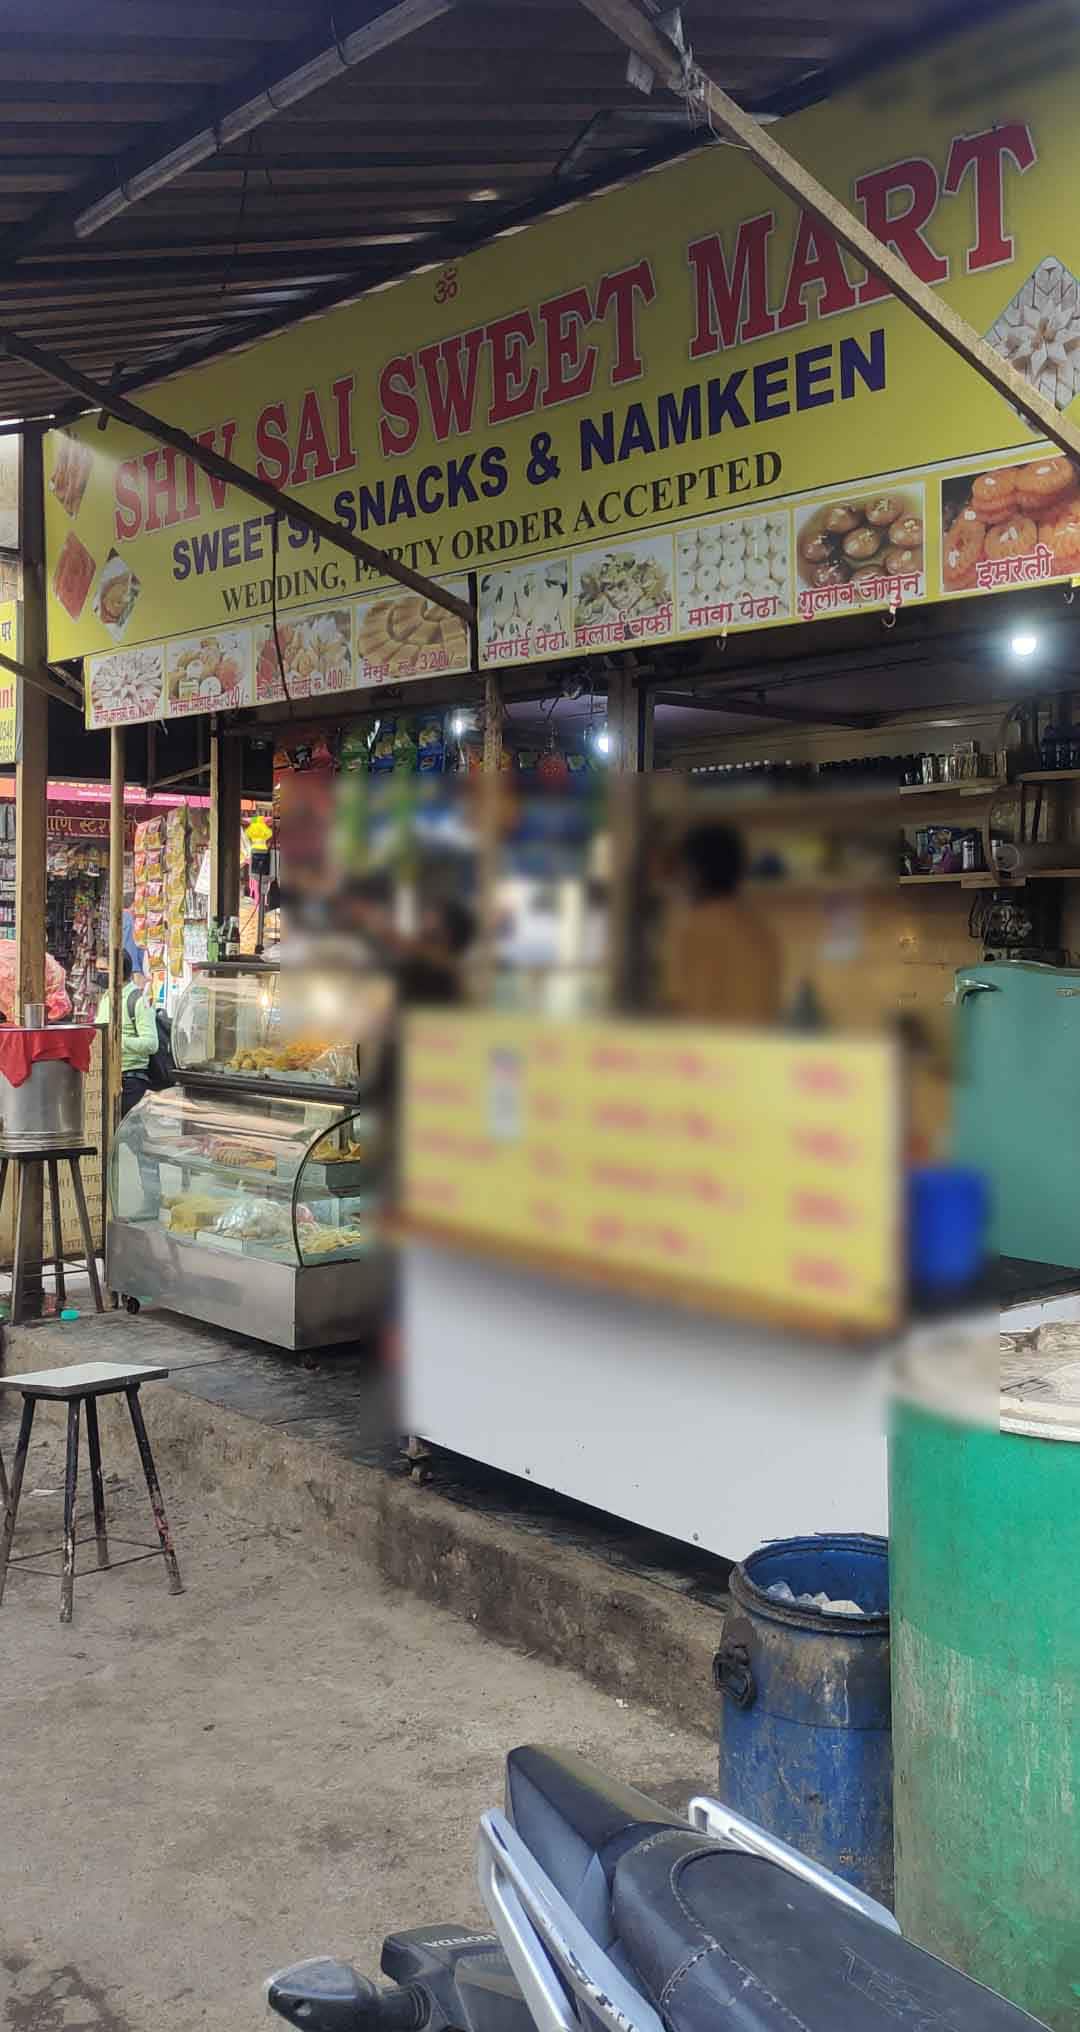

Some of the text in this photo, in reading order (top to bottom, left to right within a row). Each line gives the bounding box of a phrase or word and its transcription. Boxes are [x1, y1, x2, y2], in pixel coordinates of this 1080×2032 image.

[114, 122, 1037, 542] SHIV SAI SWEET MART
[173, 328, 886, 580] SWEETS, SNACKS & NAMKEEN
[221, 562, 346, 612] WEDDING,
[452, 506, 564, 560] ORDER
[574, 450, 783, 525] ACCEPTED
[977, 543, 1053, 588] इमरती
[688, 601, 732, 626] मावा
[798, 573, 922, 620] गुलाब जामुन
[485, 625, 531, 660] मलाई
